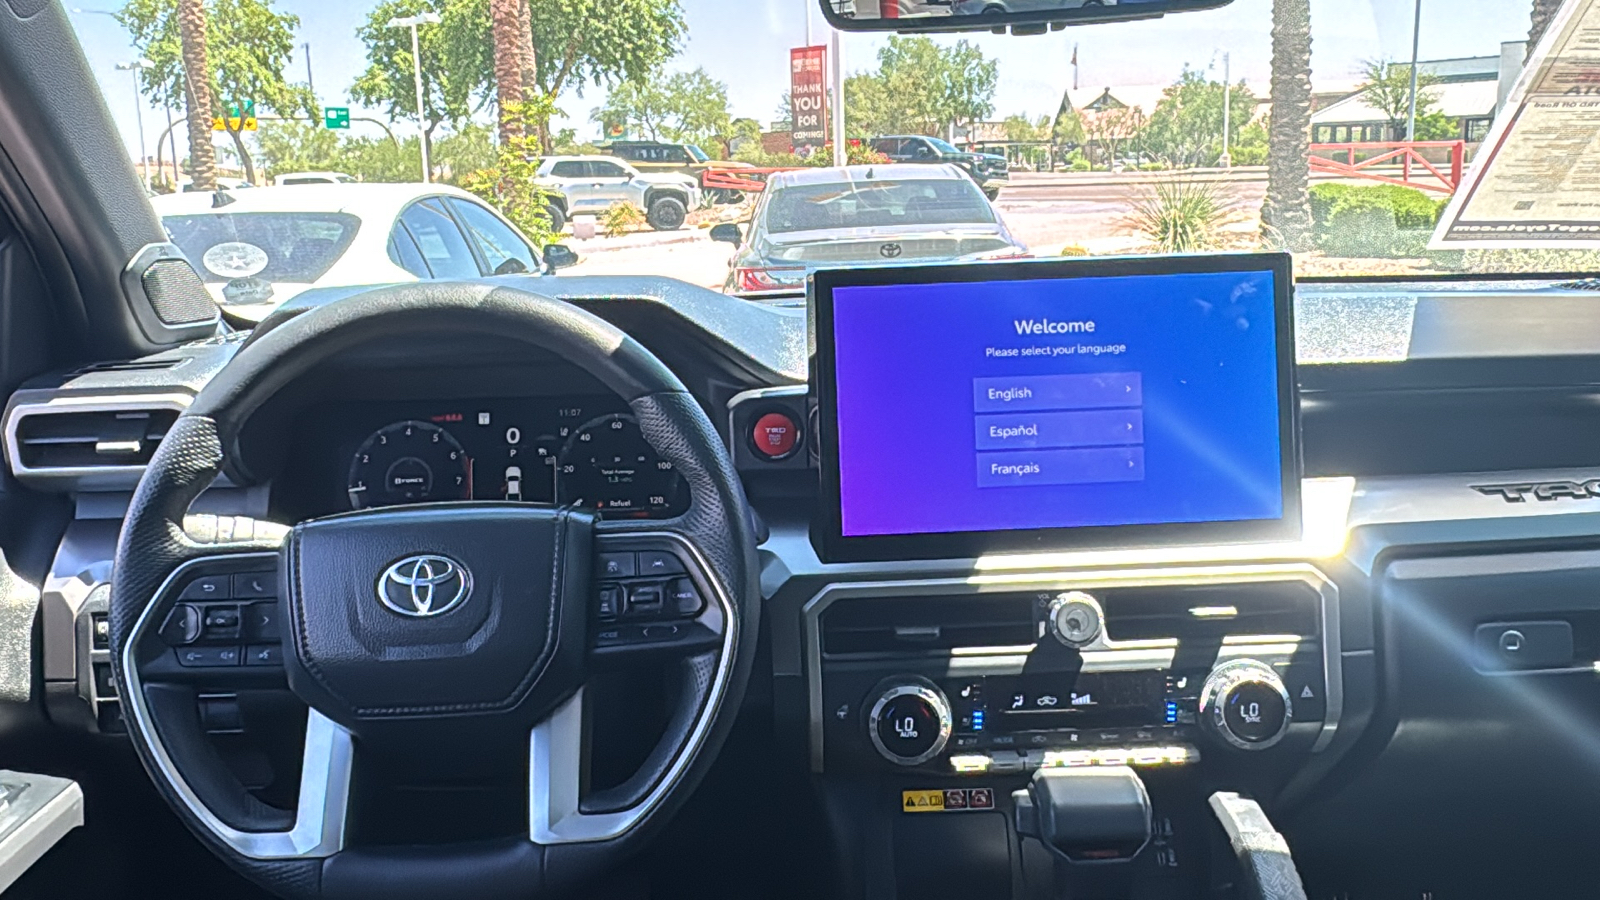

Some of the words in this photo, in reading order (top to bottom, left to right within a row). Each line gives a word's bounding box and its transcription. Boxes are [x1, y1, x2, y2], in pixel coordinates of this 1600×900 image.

[793, 83, 822, 94] THANK
[793, 96, 821, 111] YOU
[797, 115, 818, 127] FOR
[793, 130, 823, 139] COMING!
[1014, 318, 1096, 335] Welcome
[985, 347, 1019, 358] Please
[1021, 345, 1051, 356] select
[1052, 346, 1076, 357] your
[1077, 343, 1126, 356] language
[988, 387, 1032, 401] English
[559, 409, 581, 417] 11:07
[611, 422, 622, 430] 60
[405, 428, 412, 436] 4
[989, 424, 1038, 440] Español
[380, 436, 387, 445] 3
[432, 434, 439, 443] 5
[580, 434, 591, 442] 40
[450, 452, 457, 460] 6
[510, 450, 517, 458] P
[362, 455, 369, 463] 2
[563, 466, 574, 474] 20
[657, 462, 672, 470] 100
[991, 462, 1040, 477] Français
[649, 497, 664, 505] 120
[1240, 702, 1259, 718] LO
[895, 717, 914, 732] LO
